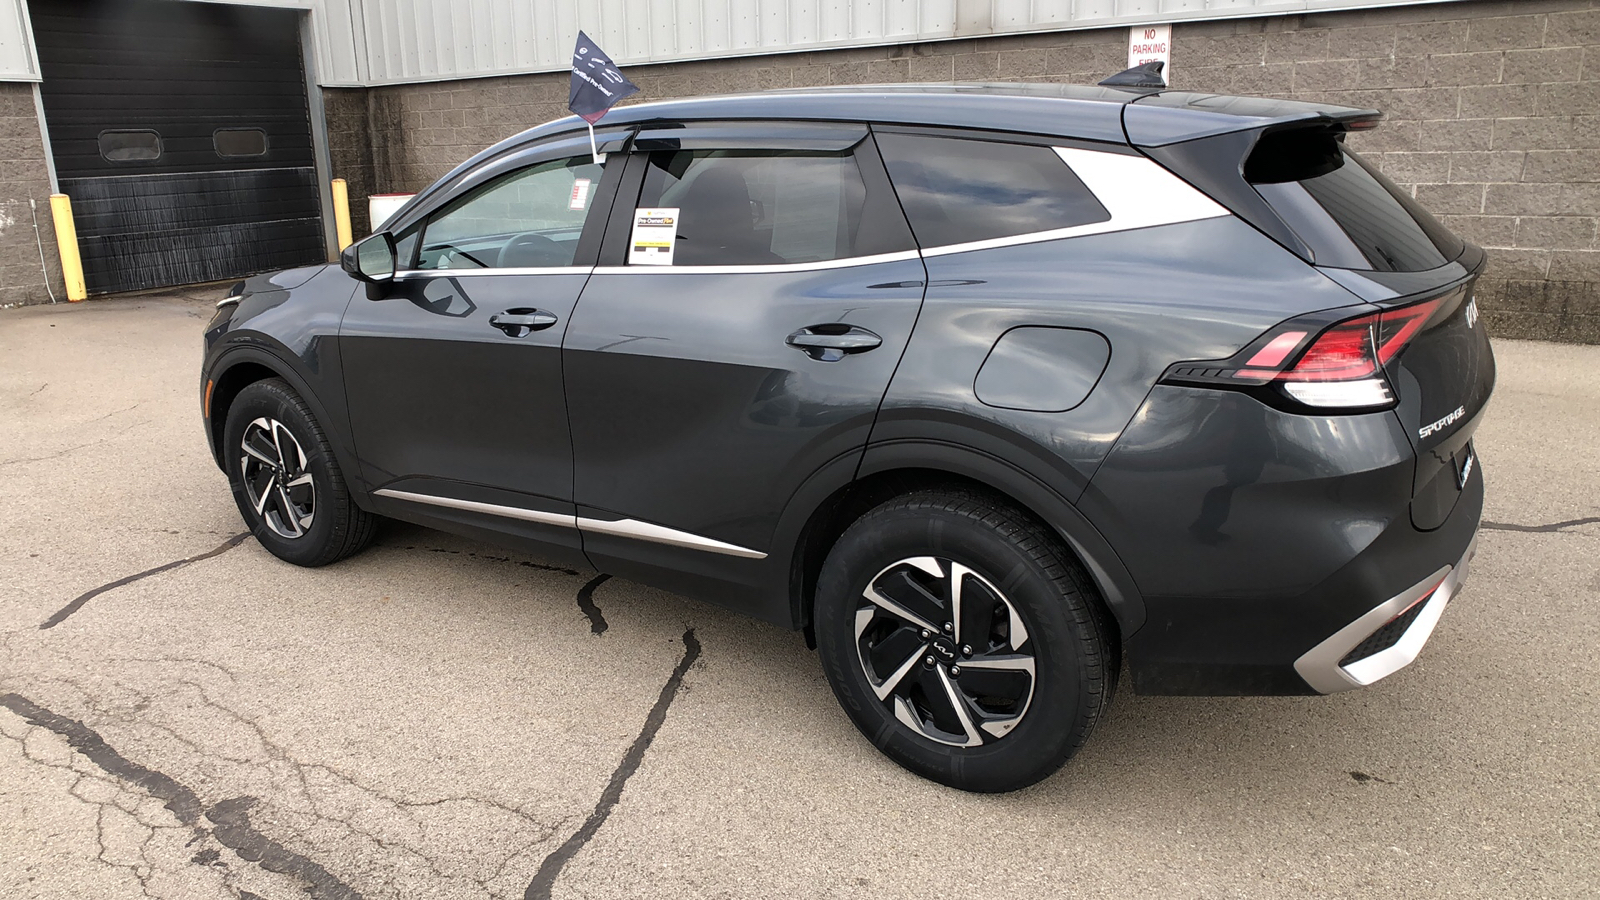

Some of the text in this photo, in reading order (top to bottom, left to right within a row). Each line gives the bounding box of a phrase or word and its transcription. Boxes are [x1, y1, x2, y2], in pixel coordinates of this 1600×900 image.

[1144, 28, 1156, 40] NO
[1132, 42, 1166, 55] PARKING
[1418, 405, 1465, 439] SPORTAGE
